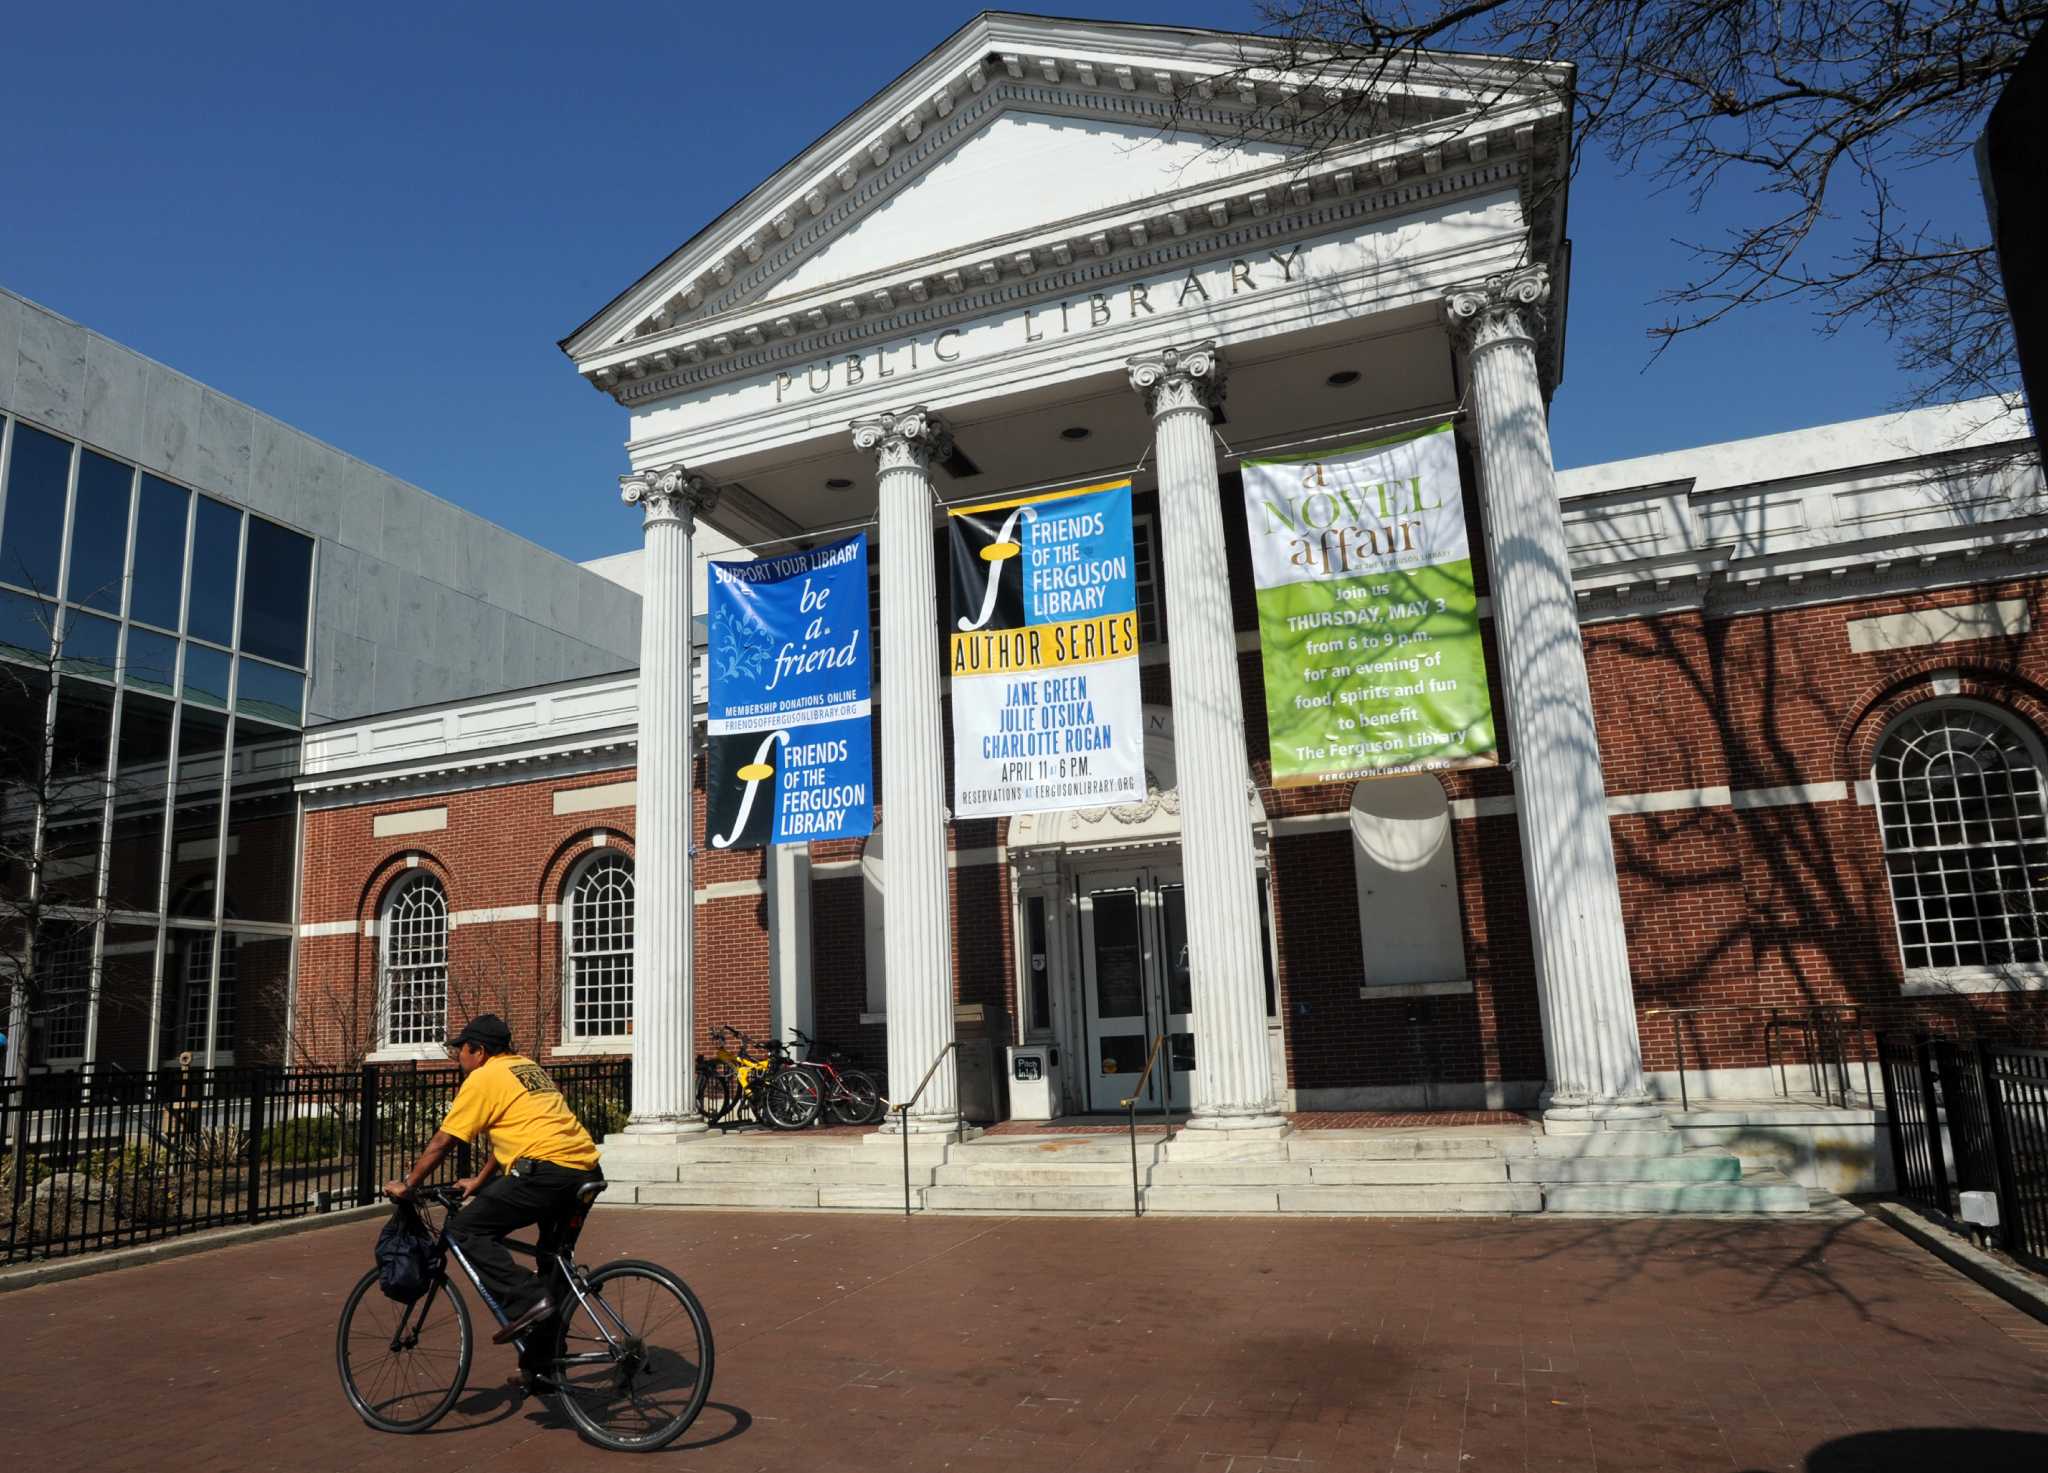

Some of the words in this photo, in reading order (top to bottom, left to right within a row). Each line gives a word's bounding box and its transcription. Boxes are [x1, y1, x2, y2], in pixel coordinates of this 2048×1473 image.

[775, 329, 960, 403] PUBLIC
[1023, 245, 1301, 343] LIBRARY
[1302, 461, 1329, 489] a
[1263, 476, 1442, 536] NOVEL
[1031, 512, 1104, 546] FRIENDS
[1032, 549, 1050, 567] OF
[1055, 543, 1081, 564] THE
[1289, 520, 1421, 576] affair
[715, 562, 771, 585] SUPPORT
[774, 556, 808, 577] YOUR
[810, 543, 860, 571] LIBRARY
[1032, 556, 1127, 593] FERGUSON
[800, 577, 831, 614] be
[1033, 586, 1106, 617] LIBRARY
[1372, 583, 1390, 596] us
[1286, 605, 1385, 633] THURSDAY,
[1388, 600, 1429, 620] MAY
[1435, 598, 1447, 613] 3
[955, 630, 1041, 673] AUTHOR
[1055, 617, 1133, 662] SERIES
[1306, 638, 1344, 655] from
[1347, 635, 1358, 650] 6
[1361, 635, 1379, 649] to
[1383, 632, 1393, 647] 9
[1398, 631, 1433, 648] p.m.
[765, 629, 860, 691] friend
[1303, 666, 1327, 682] for
[1331, 665, 1350, 678] an
[1355, 656, 1420, 675] evening
[1424, 651, 1441, 667] of
[725, 702, 777, 717] MEMBERSHIP
[779, 693, 824, 711] DONATIONS
[827, 689, 857, 704] ONLINE
[1006, 681, 1038, 707] JANE
[1043, 675, 1087, 703] GREEN
[1339, 685, 1390, 706] spirits
[1394, 679, 1424, 696] and
[1428, 677, 1457, 692] fun
[725, 704, 857, 732] FRIENDSOFFERGUSONLIBRARY.ORG
[1000, 707, 1035, 733] JULIE
[1041, 701, 1095, 730] OTSUKA
[1337, 717, 1355, 730] to
[1359, 707, 1419, 726] benefit
[784, 739, 848, 769] FRIENDS
[983, 730, 1060, 760] CHARLOTTE
[1065, 724, 1112, 753] ROGAN
[1296, 746, 1325, 761] The
[1329, 737, 1404, 759] Ferguson
[1407, 729, 1468, 749] Library
[783, 771, 800, 790] OF
[803, 768, 825, 787] THE
[1001, 761, 1034, 783] APRIL
[1038, 759, 1048, 780] 11
[1059, 758, 1067, 779] 6
[1070, 756, 1092, 778] P.M.
[1318, 760, 1451, 782] FERGUSONLIBRARY.ORG
[782, 783, 865, 814] FERGUSON
[962, 787, 1022, 805] RESERVATIONS
[1035, 776, 1135, 799] FERGUSONLIBRARY.ORG
[780, 809, 846, 837] LIBRARY
